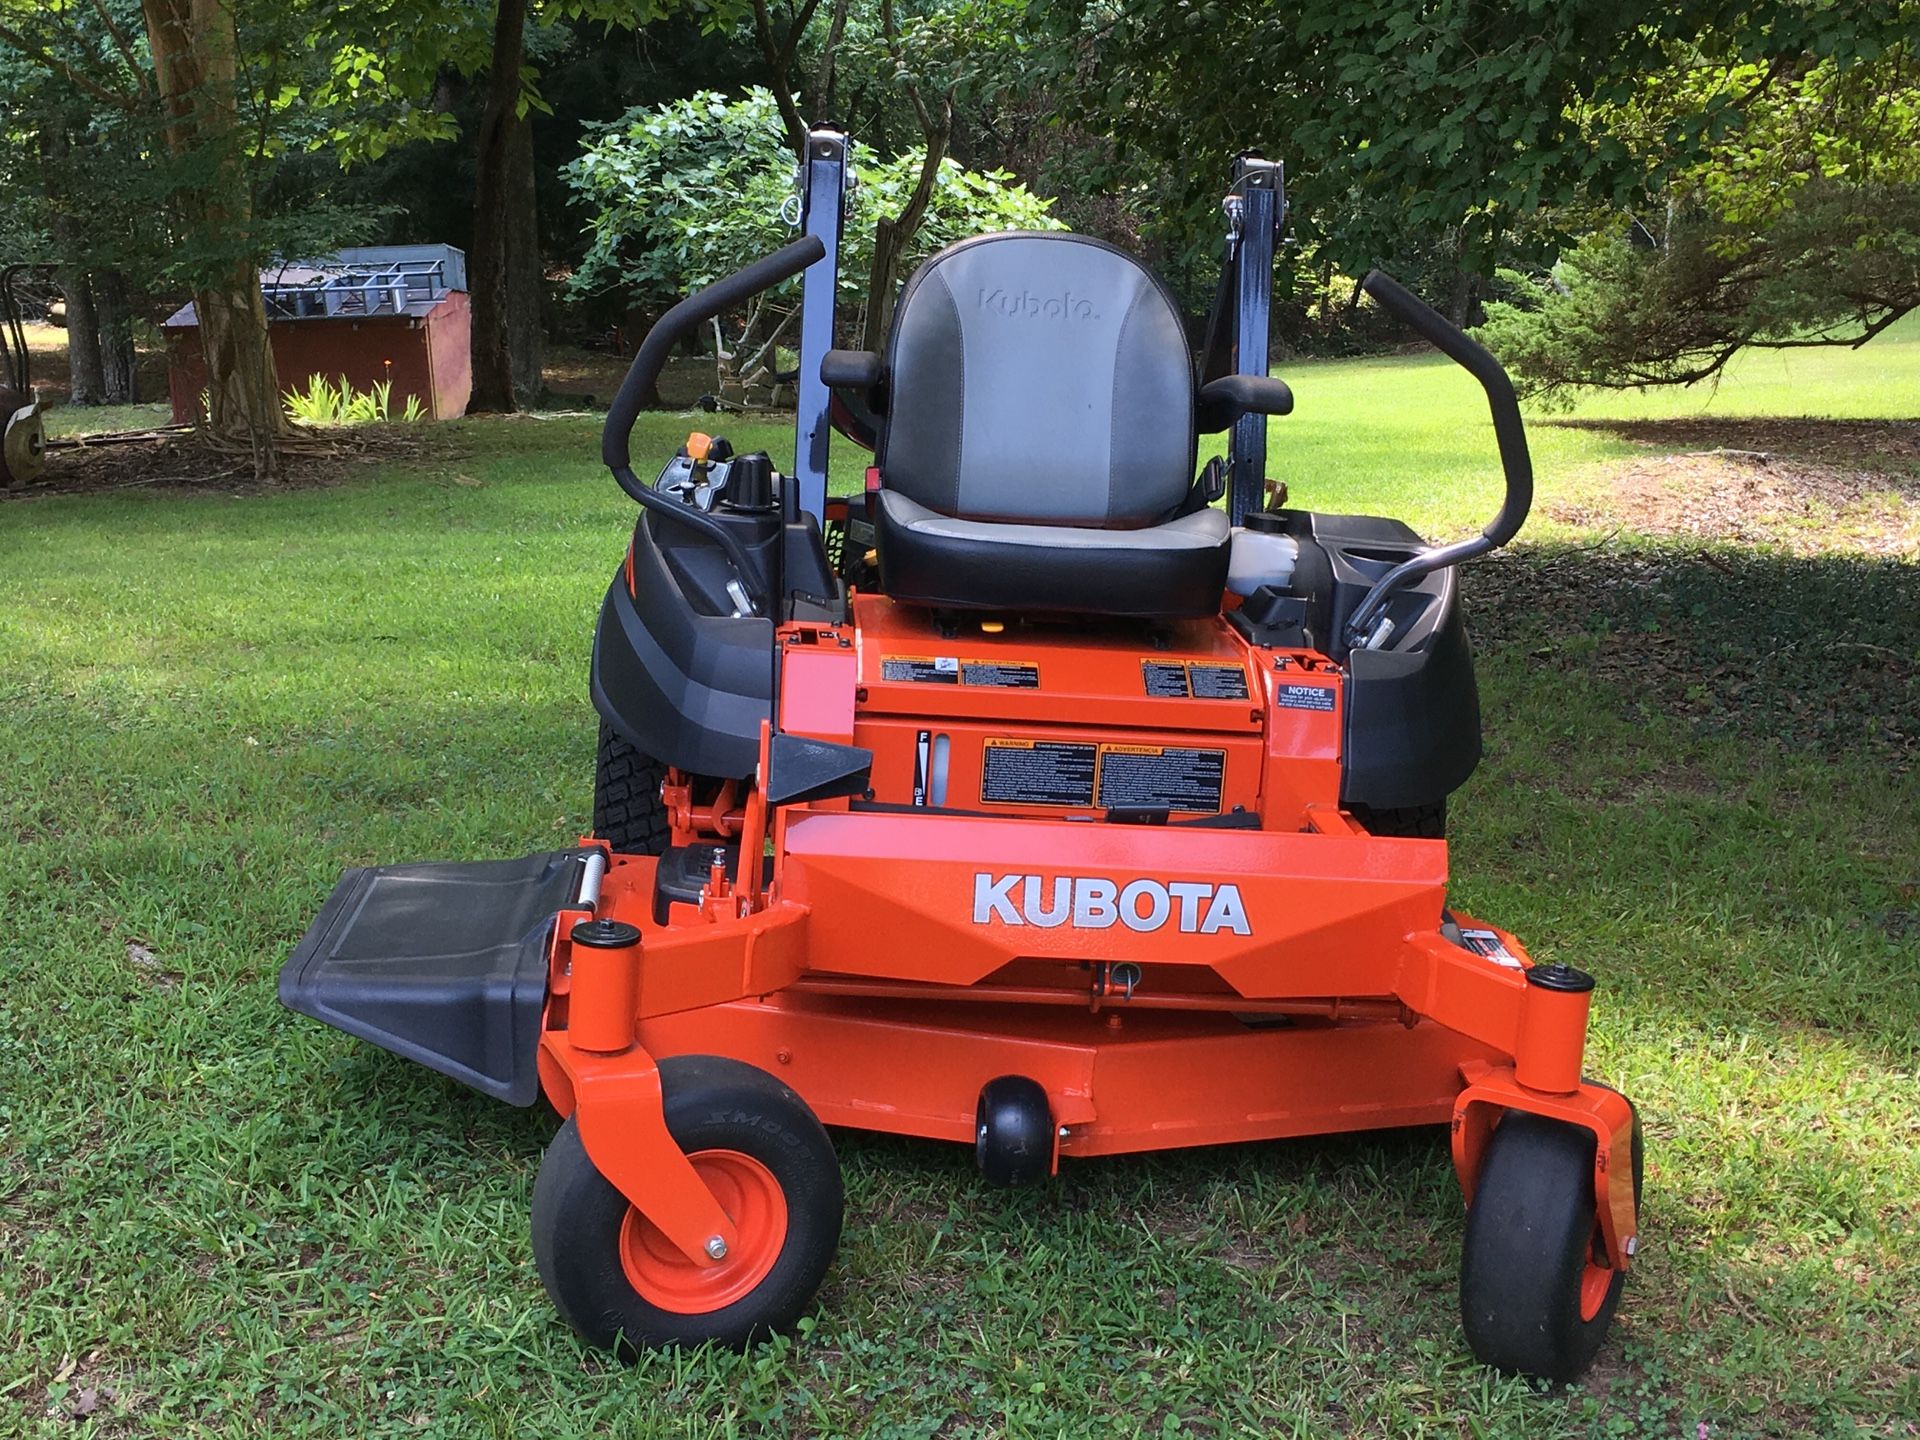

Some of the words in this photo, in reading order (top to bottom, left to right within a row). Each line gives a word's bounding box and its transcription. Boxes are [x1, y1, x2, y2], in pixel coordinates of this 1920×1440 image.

[1288, 686, 1325, 697] NOTICE
[920, 732, 928, 742] F
[1113, 746, 1159, 754] ADVERTENCIA
[915, 797, 924, 806] E
[972, 873, 1253, 935] KUBOTA
